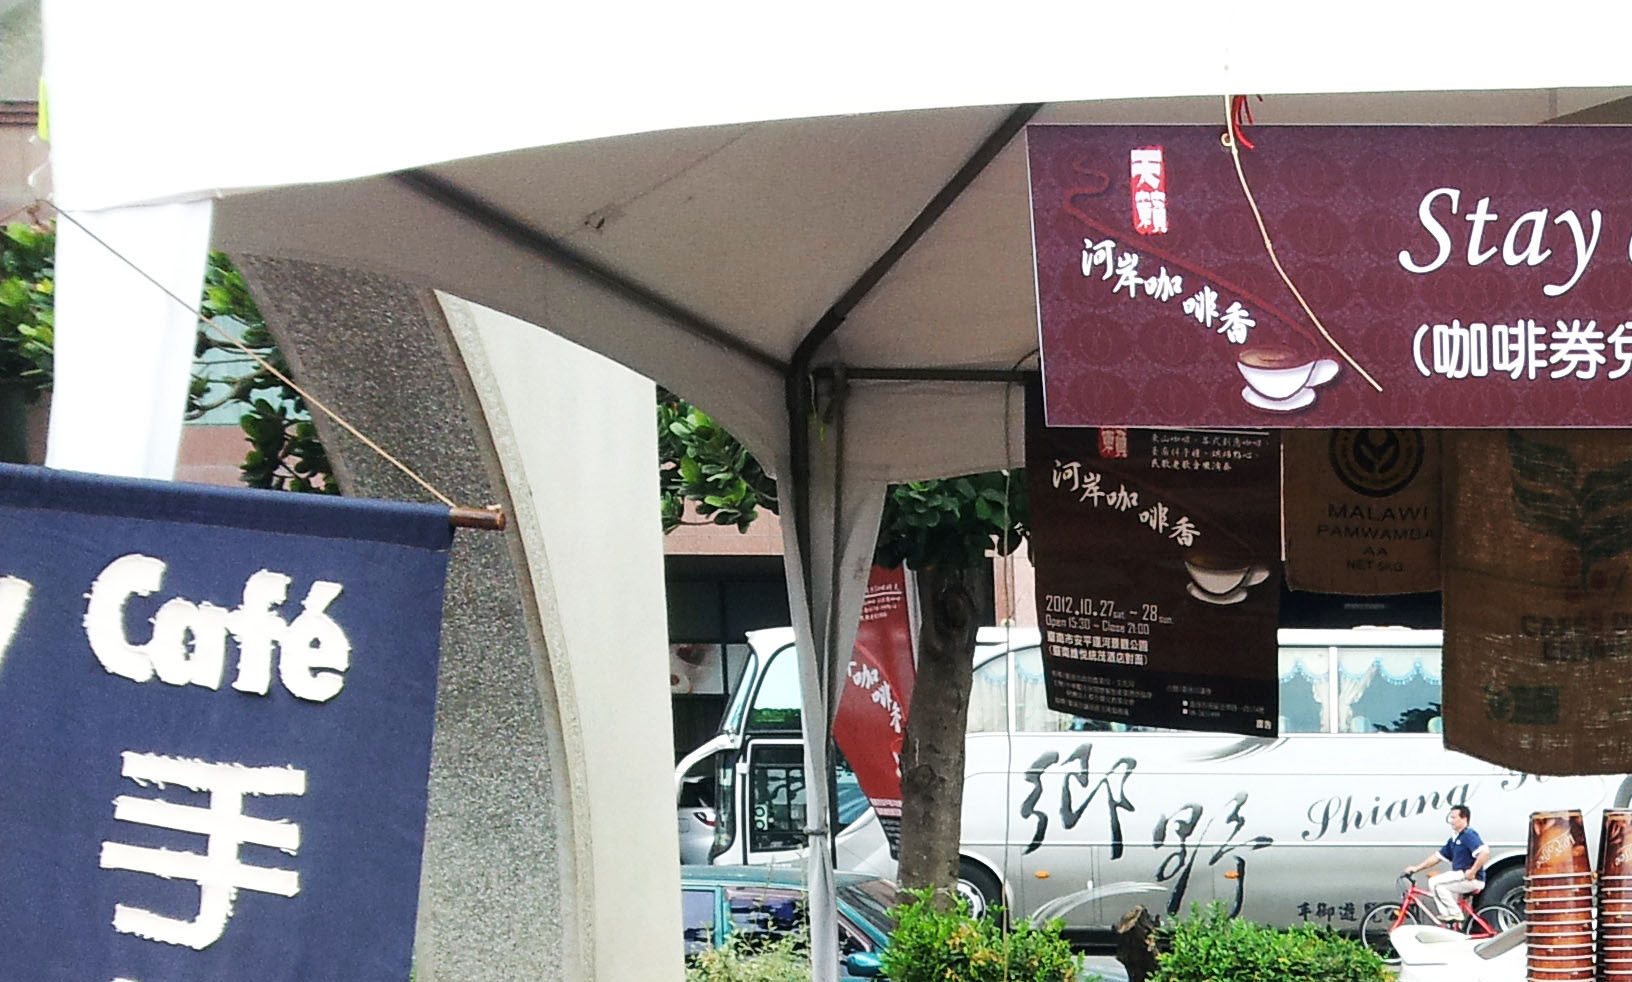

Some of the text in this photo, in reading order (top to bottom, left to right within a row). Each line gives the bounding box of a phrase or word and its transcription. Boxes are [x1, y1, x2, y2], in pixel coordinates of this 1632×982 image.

[1080, 237, 1256, 344] 河岸咖啡香
[1399, 187, 1602, 297] Stay
[1051, 459, 1201, 547] 河岸咖啡香
[1328, 503, 1429, 522] MALAWI
[83, 552, 352, 702] Café
